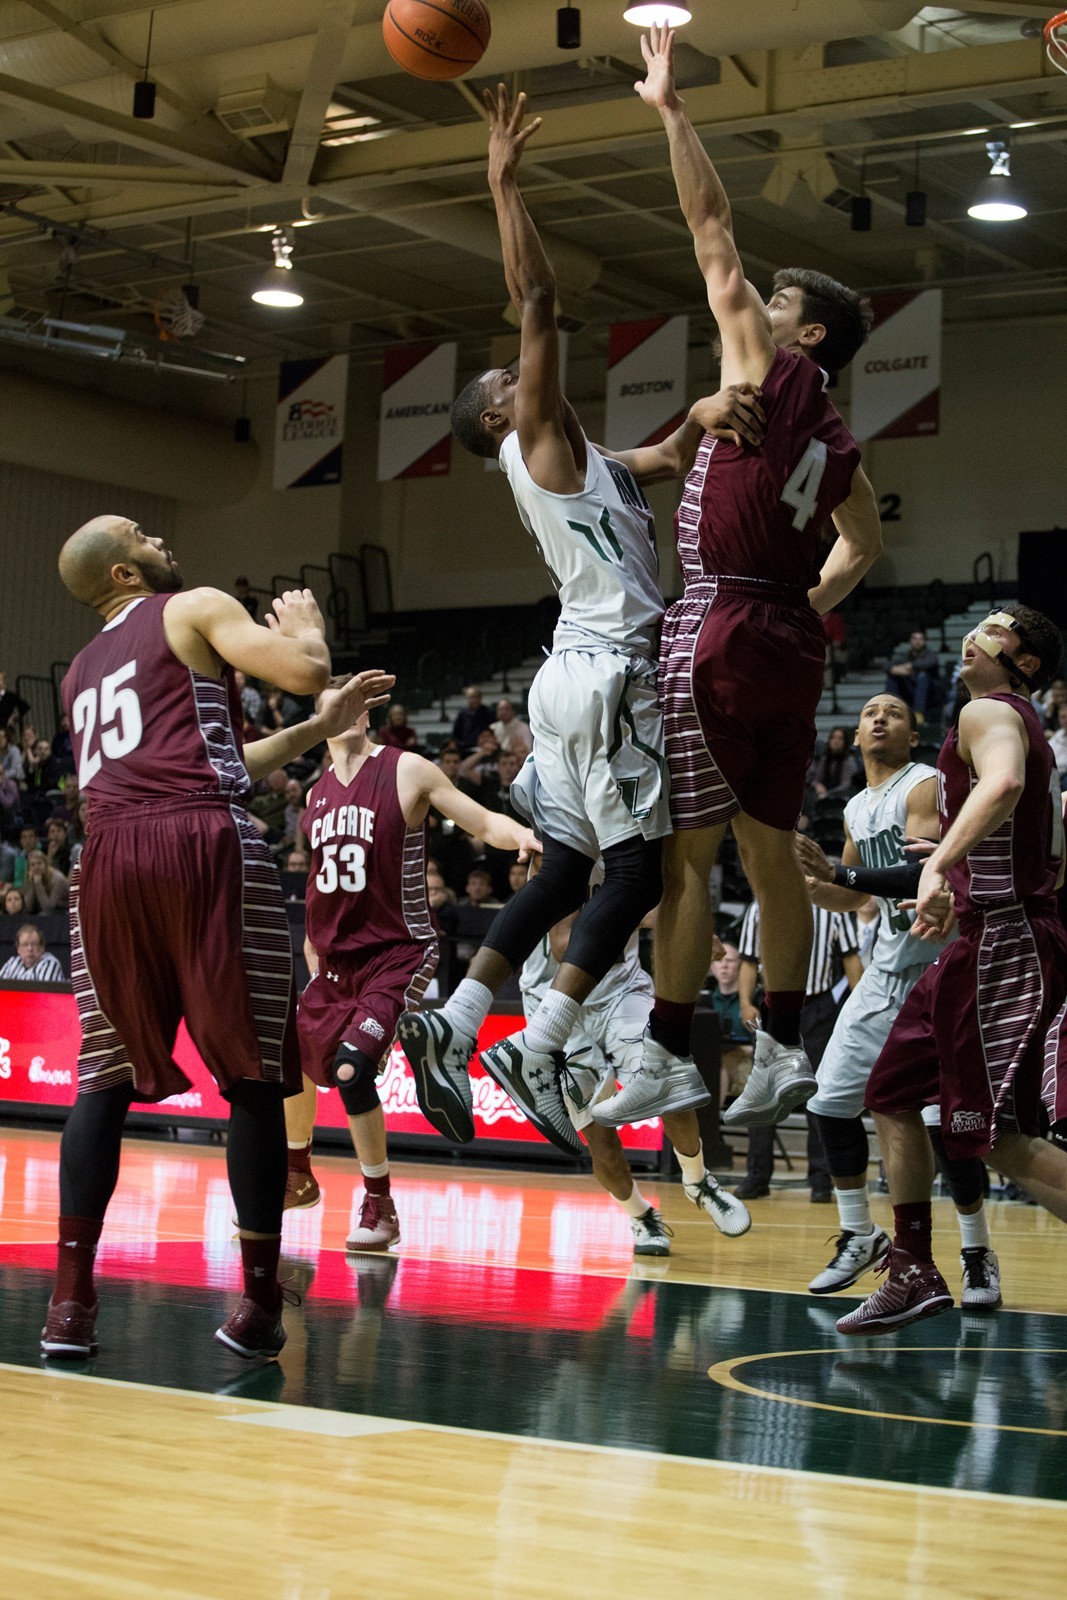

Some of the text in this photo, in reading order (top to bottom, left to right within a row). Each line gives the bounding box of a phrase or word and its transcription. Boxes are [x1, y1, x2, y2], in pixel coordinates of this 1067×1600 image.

[864, 355, 929, 374] COLGATE
[384, 402, 451, 419] AMERICAN
[620, 379, 674, 397] BOSTON
[780, 437, 828, 532] 4
[72, 659, 143, 790] 25
[311, 804, 375, 850] COLGATE
[316, 843, 367, 894] 53
